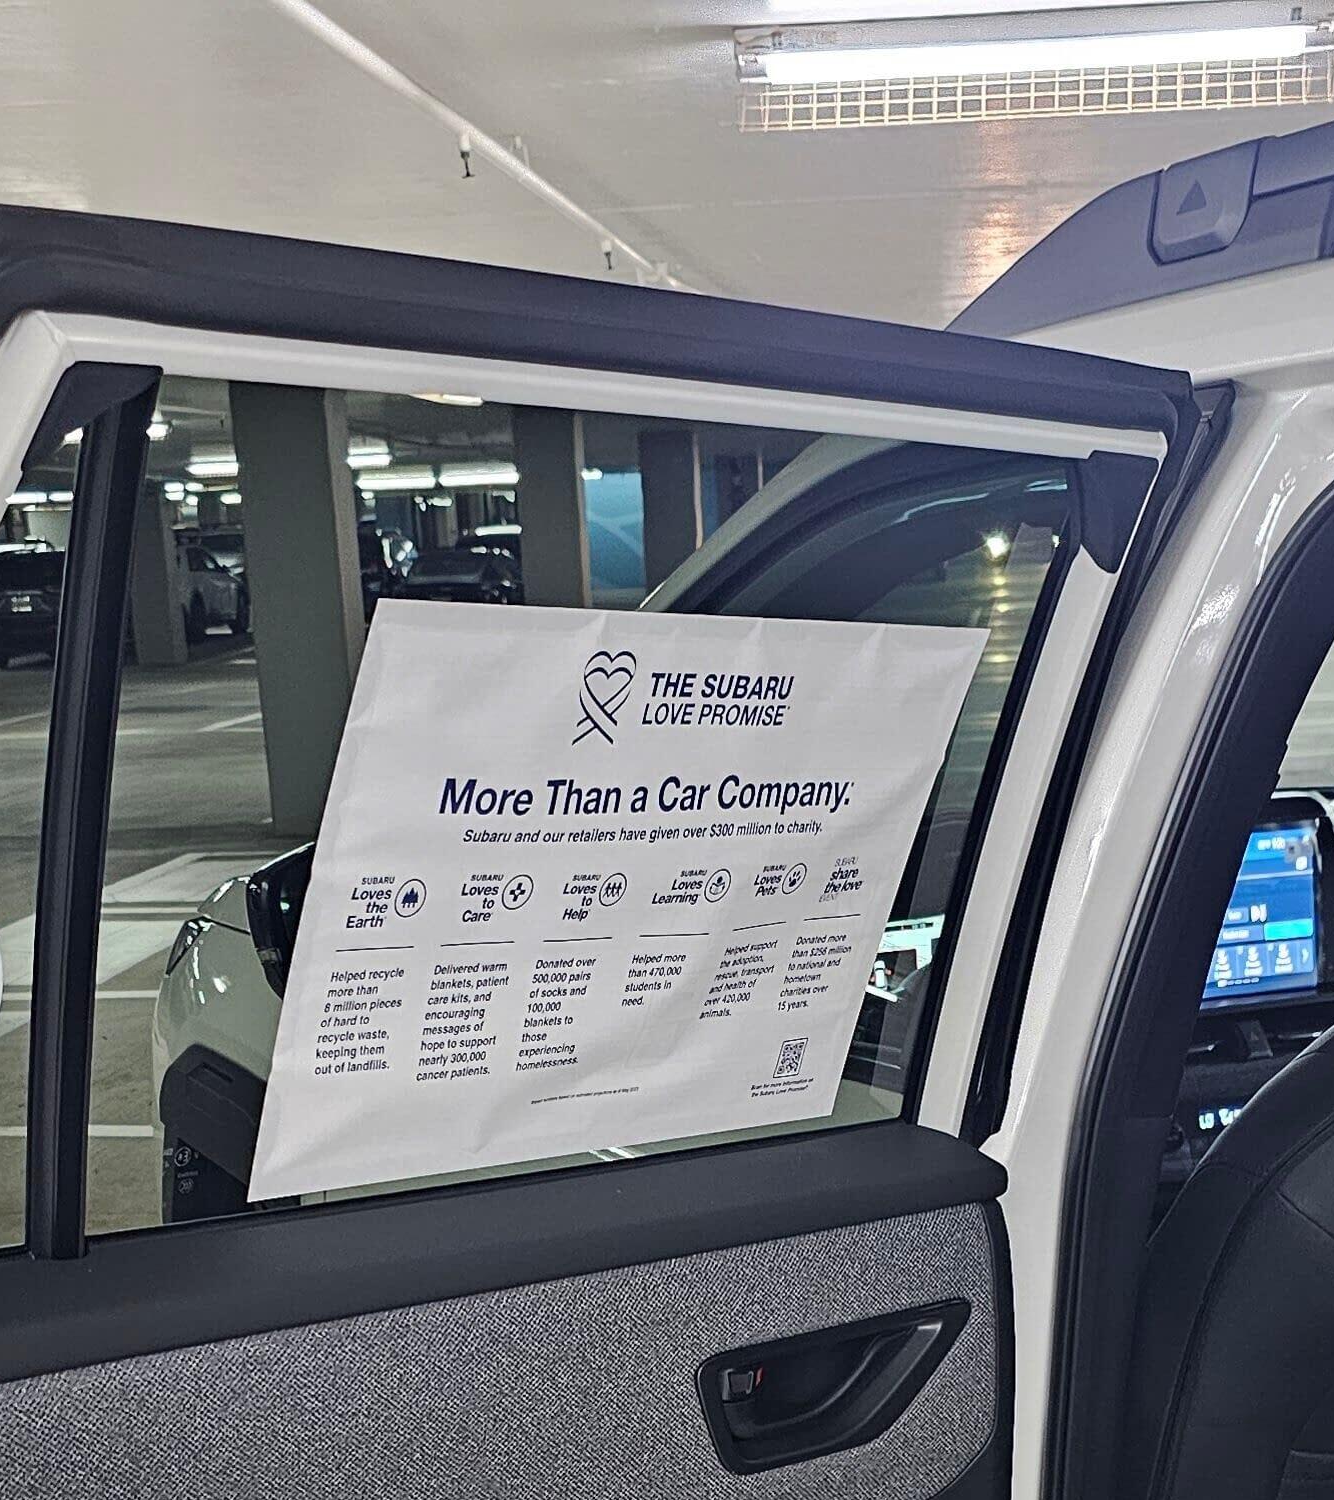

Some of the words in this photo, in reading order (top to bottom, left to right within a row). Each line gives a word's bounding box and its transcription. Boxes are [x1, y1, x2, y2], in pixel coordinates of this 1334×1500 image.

[652, 672, 697, 698] THE
[701, 674, 794, 700] SUBARU
[642, 703, 695, 725] LOVE
[698, 704, 787, 726] PROMISE
[439, 778, 533, 816] More
[546, 779, 621, 815] Than
[630, 786, 647, 813] a
[658, 776, 710, 812] Car
[717, 775, 851, 814] Company.
[463, 829, 511, 843] Subaru
[515, 830, 541, 843] and
[543, 831, 565, 842] our
[568, 829, 616, 842] retailers
[618, 827, 646, 841] have
[649, 826, 680, 843] given
[683, 826, 708, 838] over
[710, 823, 734, 837] $300
[736, 822, 771, 836] million
[774, 822, 784, 834] to
[787, 819, 823, 835] charity.
[361, 877, 395, 885] SUBARU
[471, 874, 504, 882] SUBARU
[572, 874, 601, 882] SUBARU
[754, 874, 782, 886] Loves
[830, 868, 859, 881] share
[461, 884, 499, 897] Loves
[563, 883, 597, 895] Loves
[671, 879, 703, 891] Loves
[755, 886, 777, 897] Pets
[824, 882, 841, 894] the
[841, 880, 862, 892] love
[351, 888, 392, 900] Loves
[652, 893, 699, 905] Learning
[367, 901, 388, 914] the
[482, 898, 495, 910] to
[581, 896, 592, 907] to
[346, 915, 384, 928] Earth
[462, 910, 491, 923] Care
[562, 908, 588, 922] Help
[796, 934, 827, 946] Donated
[828, 934, 847, 943] more
[724, 944, 749, 956] Helped
[750, 940, 778, 952] support
[792, 949, 809, 958] than
[828, 945, 851, 954] million
[535, 959, 573, 970] Donated
[575, 958, 596, 967] over
[632, 954, 662, 966] Helped
[664, 954, 686, 963] more
[720, 959, 731, 968] the
[732, 954, 764, 966] adoption,
[788, 962, 796, 971] to
[797, 959, 826, 970] national
[827, 958, 841, 967] and
[331, 970, 366, 983] Helped
[368, 968, 404, 981] recycle
[434, 964, 480, 976] Delivered
[482, 962, 507, 972] warm
[628, 969, 647, 978] than
[649, 966, 682, 977] 470,000
[741, 965, 775, 978] transport
[431, 980, 474, 990] blankets,
[476, 976, 509, 990] patient
[532, 973, 567, 984] 500,000
[569, 972, 591, 984] pairs
[784, 973, 821, 984] hometown
[328, 988, 354, 998] more
[357, 985, 379, 995] than
[530, 989, 540, 999] of
[542, 988, 567, 998] socks
[569, 986, 587, 995] and
[625, 982, 661, 992] students
[664, 980, 671, 989] in
[709, 985, 723, 994] and
[724, 981, 746, 992] health
[748, 979, 757, 988] of
[780, 986, 811, 998] charities
[812, 984, 829, 994] over
[428, 995, 449, 1005] care
[451, 995, 471, 1004] kits,
[473, 991, 492, 1002] and
[622, 996, 644, 1007] need.
[704, 997, 720, 1006] over
[722, 992, 751, 1003] 420,000
[333, 1001, 367, 1012] million
[369, 999, 402, 1012] pieces
[527, 1001, 562, 1013] 100,000
[778, 1001, 786, 1011] 15
[786, 999, 808, 1012] years.
[425, 1008, 485, 1020] encouraging
[699, 1008, 731, 1020] animals.
[320, 1017, 332, 1028] of
[333, 1015, 358, 1027] hard
[359, 1016, 370, 1025] to
[524, 1016, 562, 1028] blankets
[564, 1016, 573, 1025] to
[422, 1024, 471, 1036] messages
[473, 1021, 484, 1032] of
[317, 1031, 355, 1045] recycle
[358, 1030, 390, 1040] waste,
[420, 1039, 445, 1052] hope
[447, 1039, 457, 1048] to
[459, 1036, 497, 1051] support
[522, 1032, 547, 1043] those
[316, 1047, 356, 1060] keeping
[360, 1045, 385, 1055] them
[519, 1043, 575, 1058] experiencing
[418, 1054, 448, 1067] nearly
[450, 1051, 487, 1063] 300,000
[516, 1056, 578, 1072] homelessness.
[315, 1064, 331, 1075] out
[334, 1062, 345, 1073] of
[347, 1060, 390, 1072] landfills.
[416, 1069, 448, 1081] cancer
[450, 1066, 490, 1081] patients.
